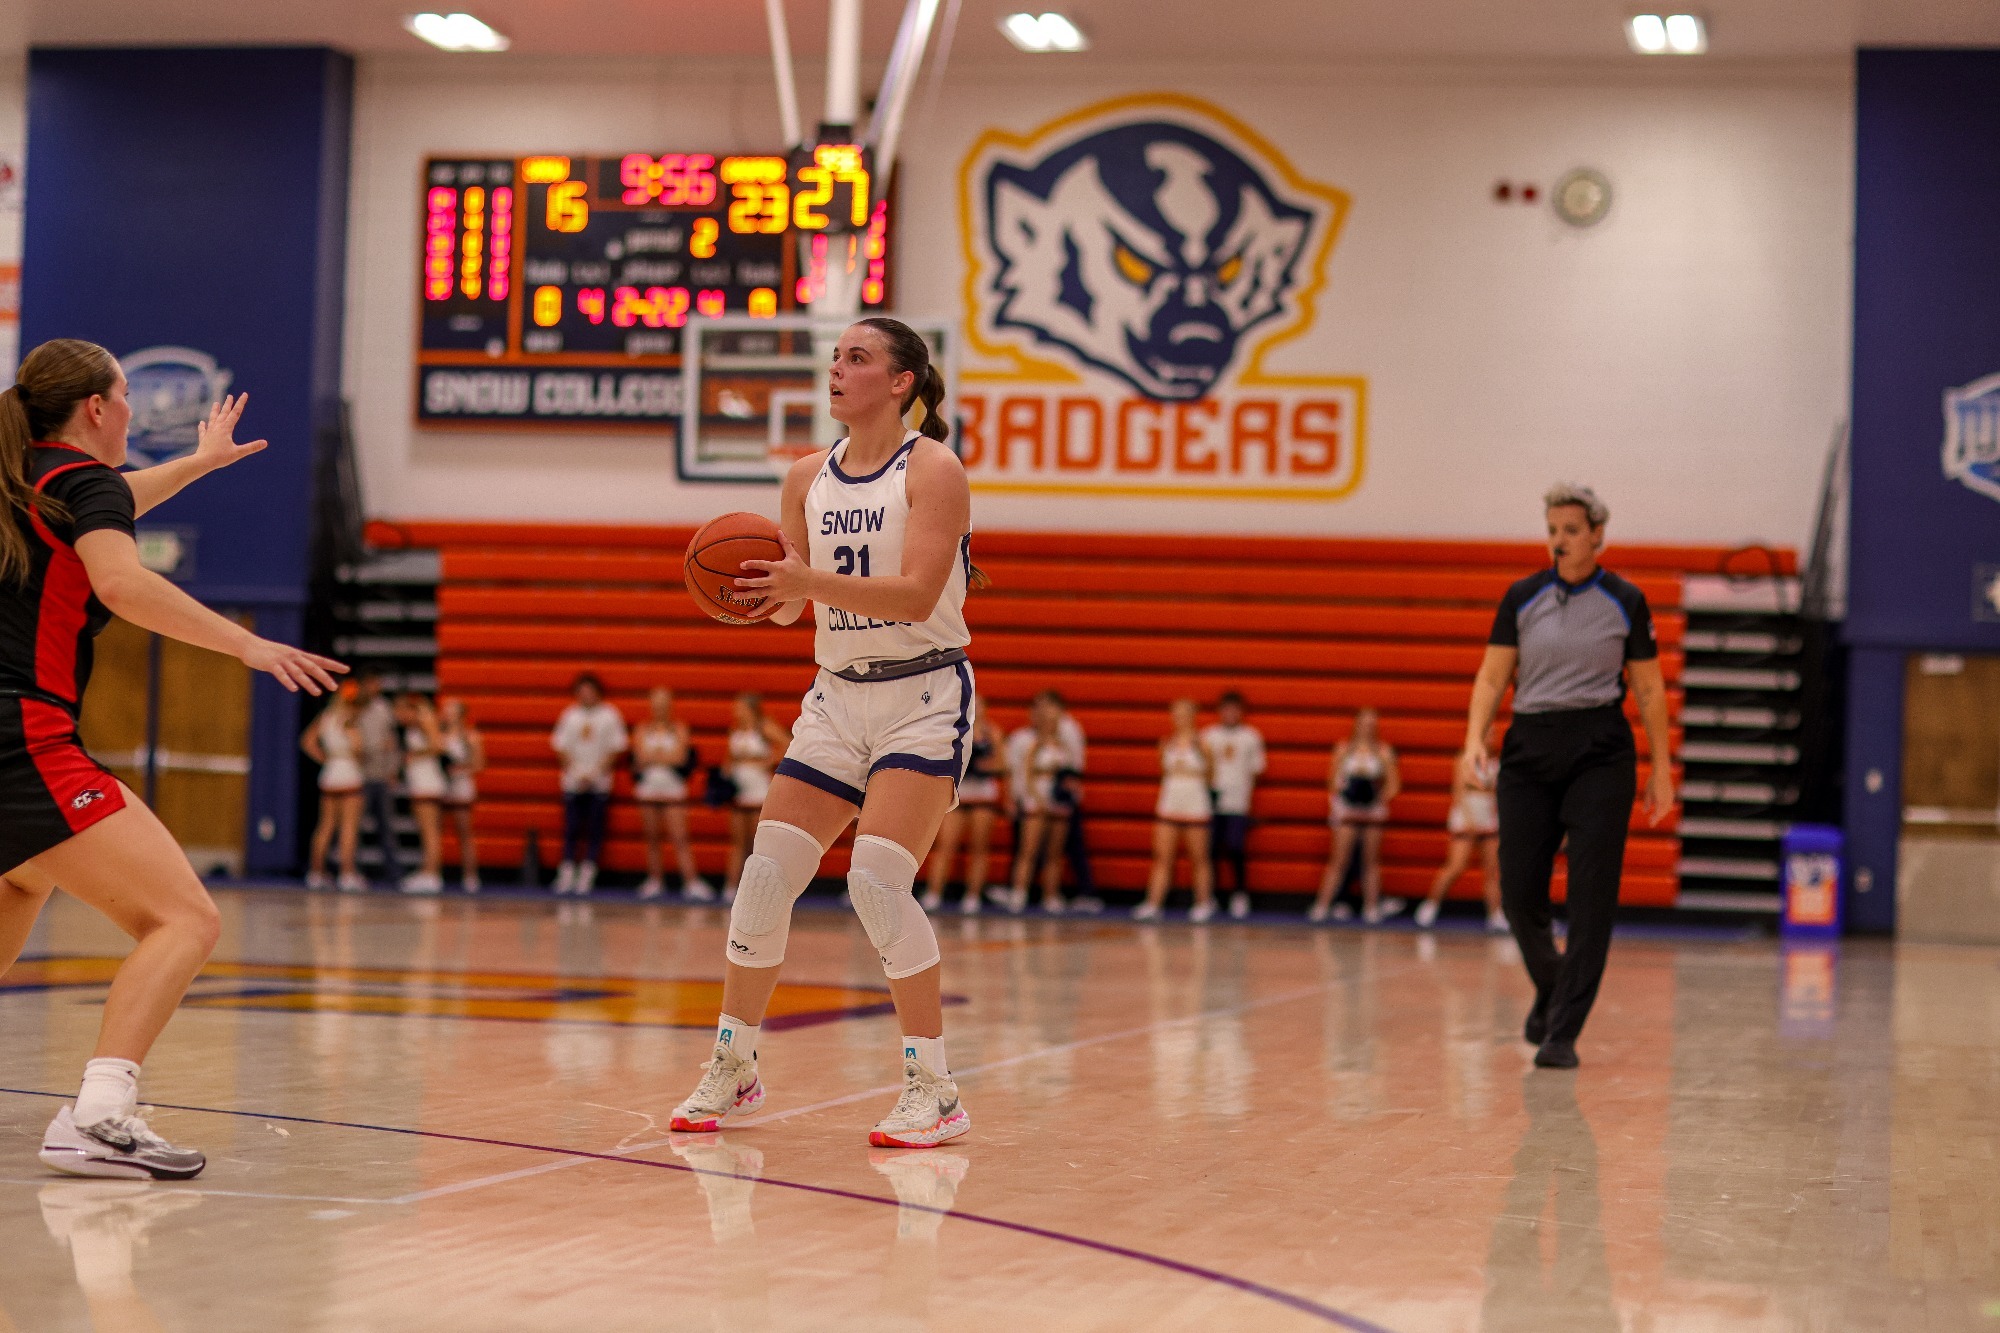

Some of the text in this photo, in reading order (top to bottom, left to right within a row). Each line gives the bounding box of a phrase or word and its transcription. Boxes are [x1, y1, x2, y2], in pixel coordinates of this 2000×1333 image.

[793, 164, 870, 229] 27
[690, 217, 719, 258] 2
[426, 371, 532, 414] SNOW
[959, 396, 1341, 476] BADGERS
[820, 506, 886, 536] SNOW
[833, 544, 871, 578] 21
